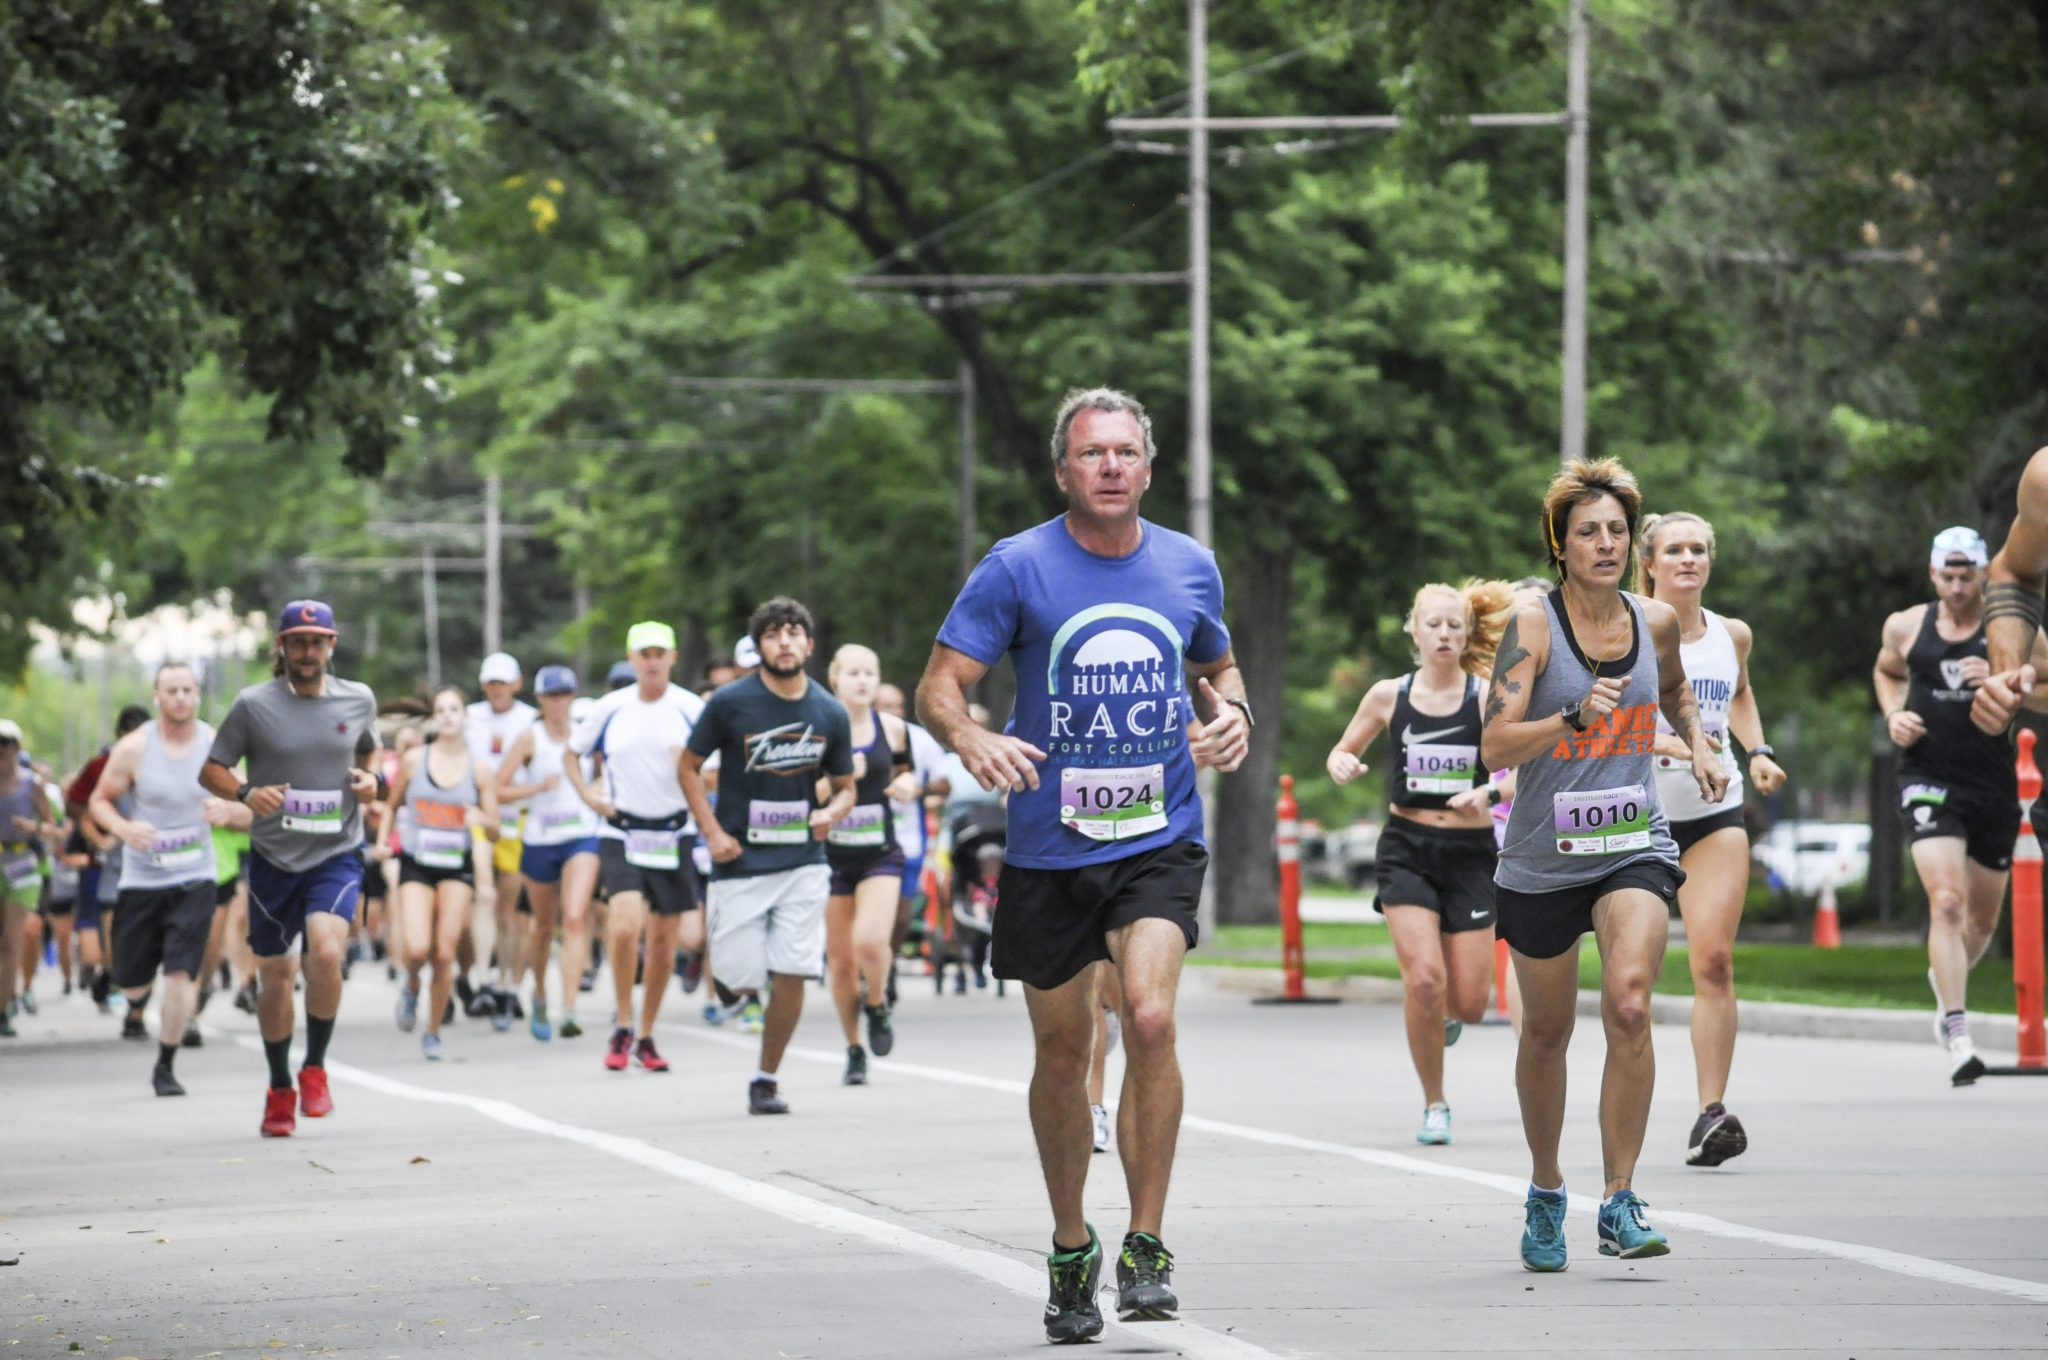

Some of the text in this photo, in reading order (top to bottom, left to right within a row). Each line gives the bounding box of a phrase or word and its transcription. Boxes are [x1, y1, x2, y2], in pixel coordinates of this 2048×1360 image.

[301, 605, 318, 623] C
[1072, 671, 1166, 695] HUMAN
[1691, 679, 1730, 702] TITUDE
[1049, 696, 1181, 738] RACE
[1572, 703, 1657, 738] ANIC
[1048, 737, 1176, 755] FORT COLLINS
[1417, 756, 1468, 772] 1045
[1075, 783, 1153, 809] 1024
[1568, 801, 1638, 828] 1010
